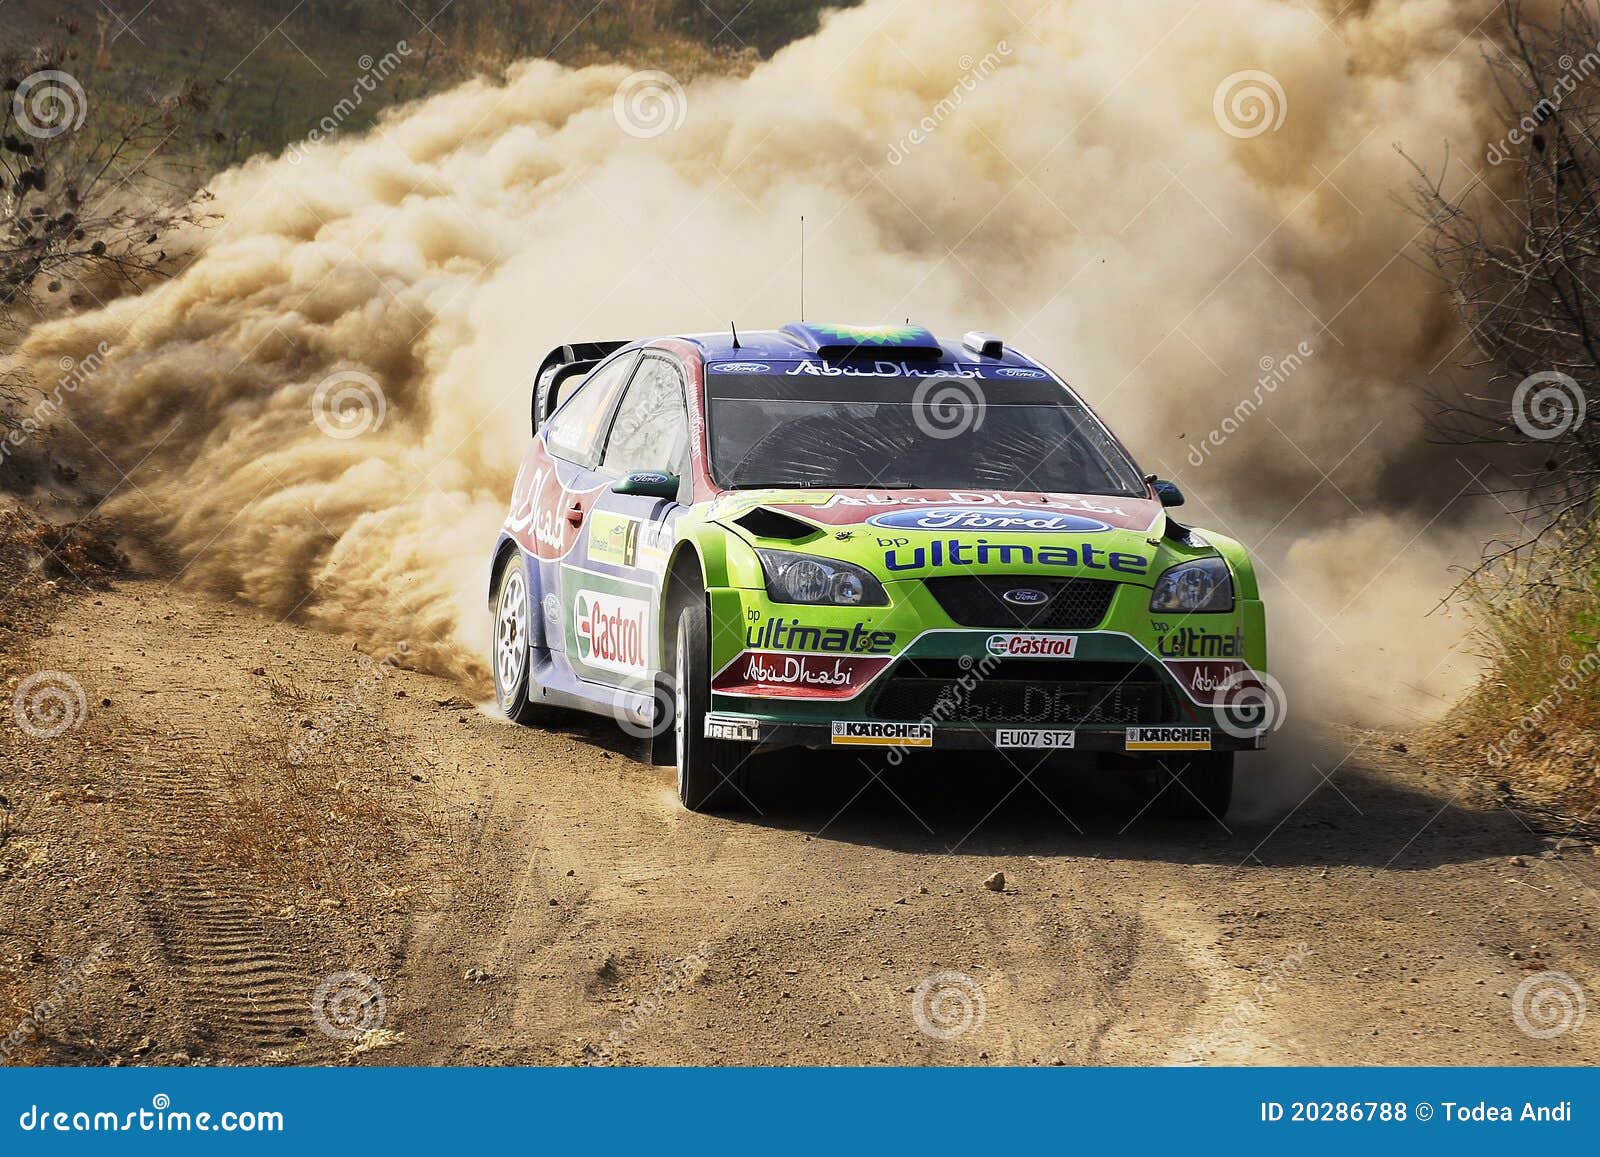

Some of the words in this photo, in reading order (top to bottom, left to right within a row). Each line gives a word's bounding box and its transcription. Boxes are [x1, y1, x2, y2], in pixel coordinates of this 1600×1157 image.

[917, 508, 1067, 529] Ford
[876, 535, 909, 548] bp
[884, 539, 1148, 575] ultimate
[747, 607, 761, 623] bp
[592, 601, 645, 666] Castrol
[1150, 619, 1169, 632] bp
[746, 618, 897, 653] ultimate
[1008, 636, 1072, 655] Castrol
[1000, 732, 1038, 746] EU07
[1043, 732, 1071, 746] STZ
